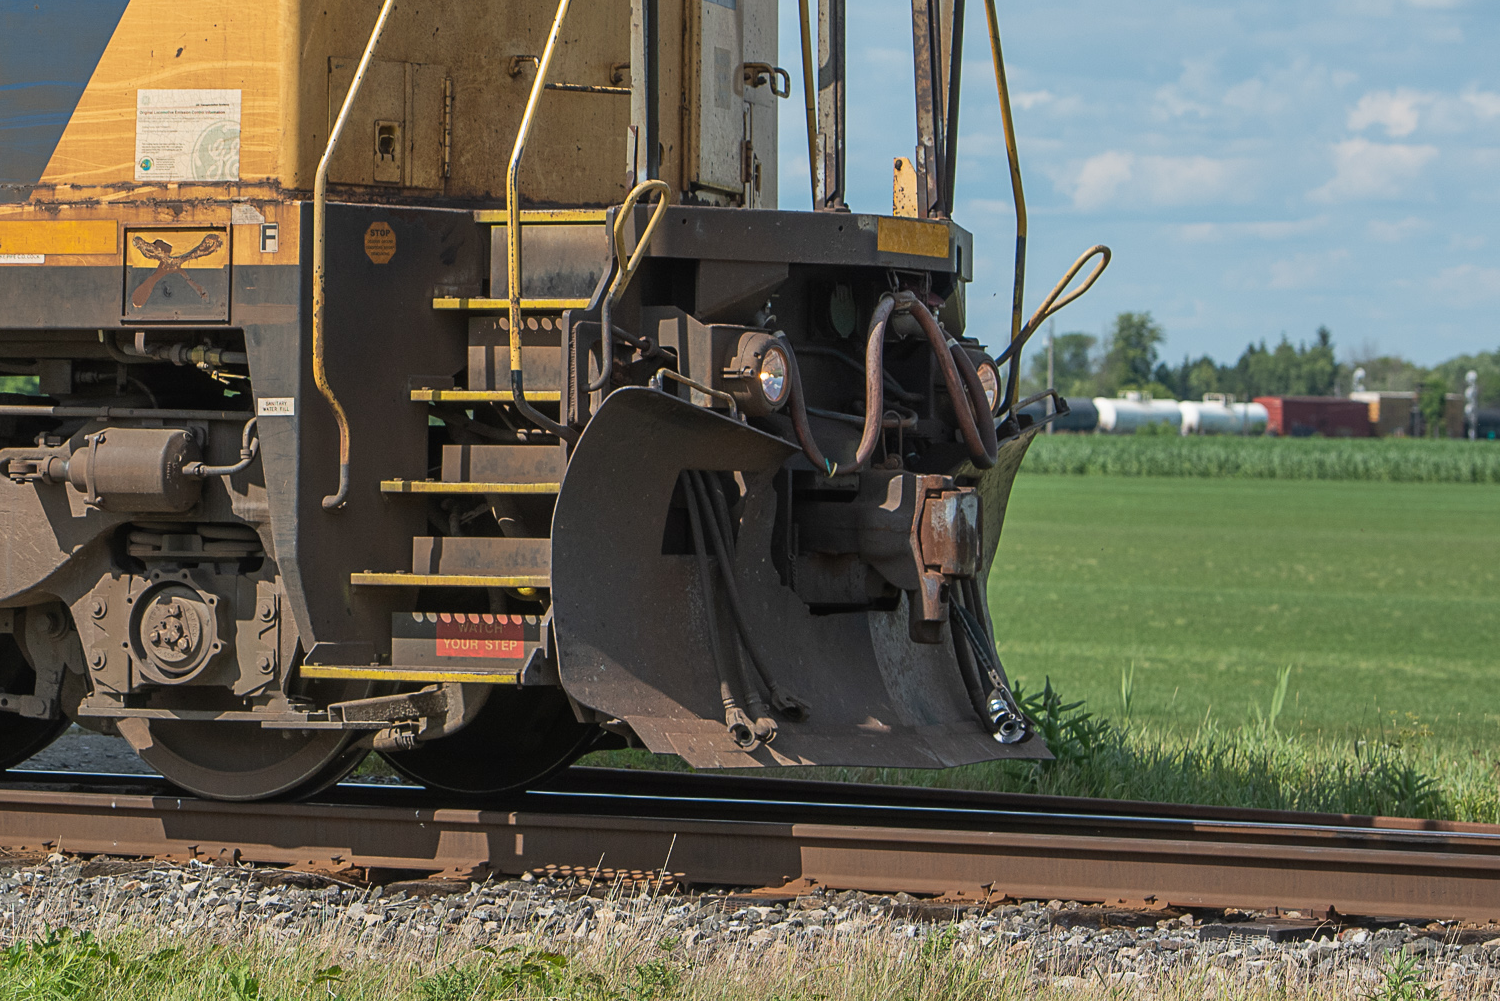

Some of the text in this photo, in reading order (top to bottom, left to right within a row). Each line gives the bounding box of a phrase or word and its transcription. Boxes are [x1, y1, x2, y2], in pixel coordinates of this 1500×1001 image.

[261, 224, 277, 250] F
[370, 229, 390, 237] STOP
[458, 622, 503, 634] WATCH
[443, 638, 518, 651] YOUR STEP
